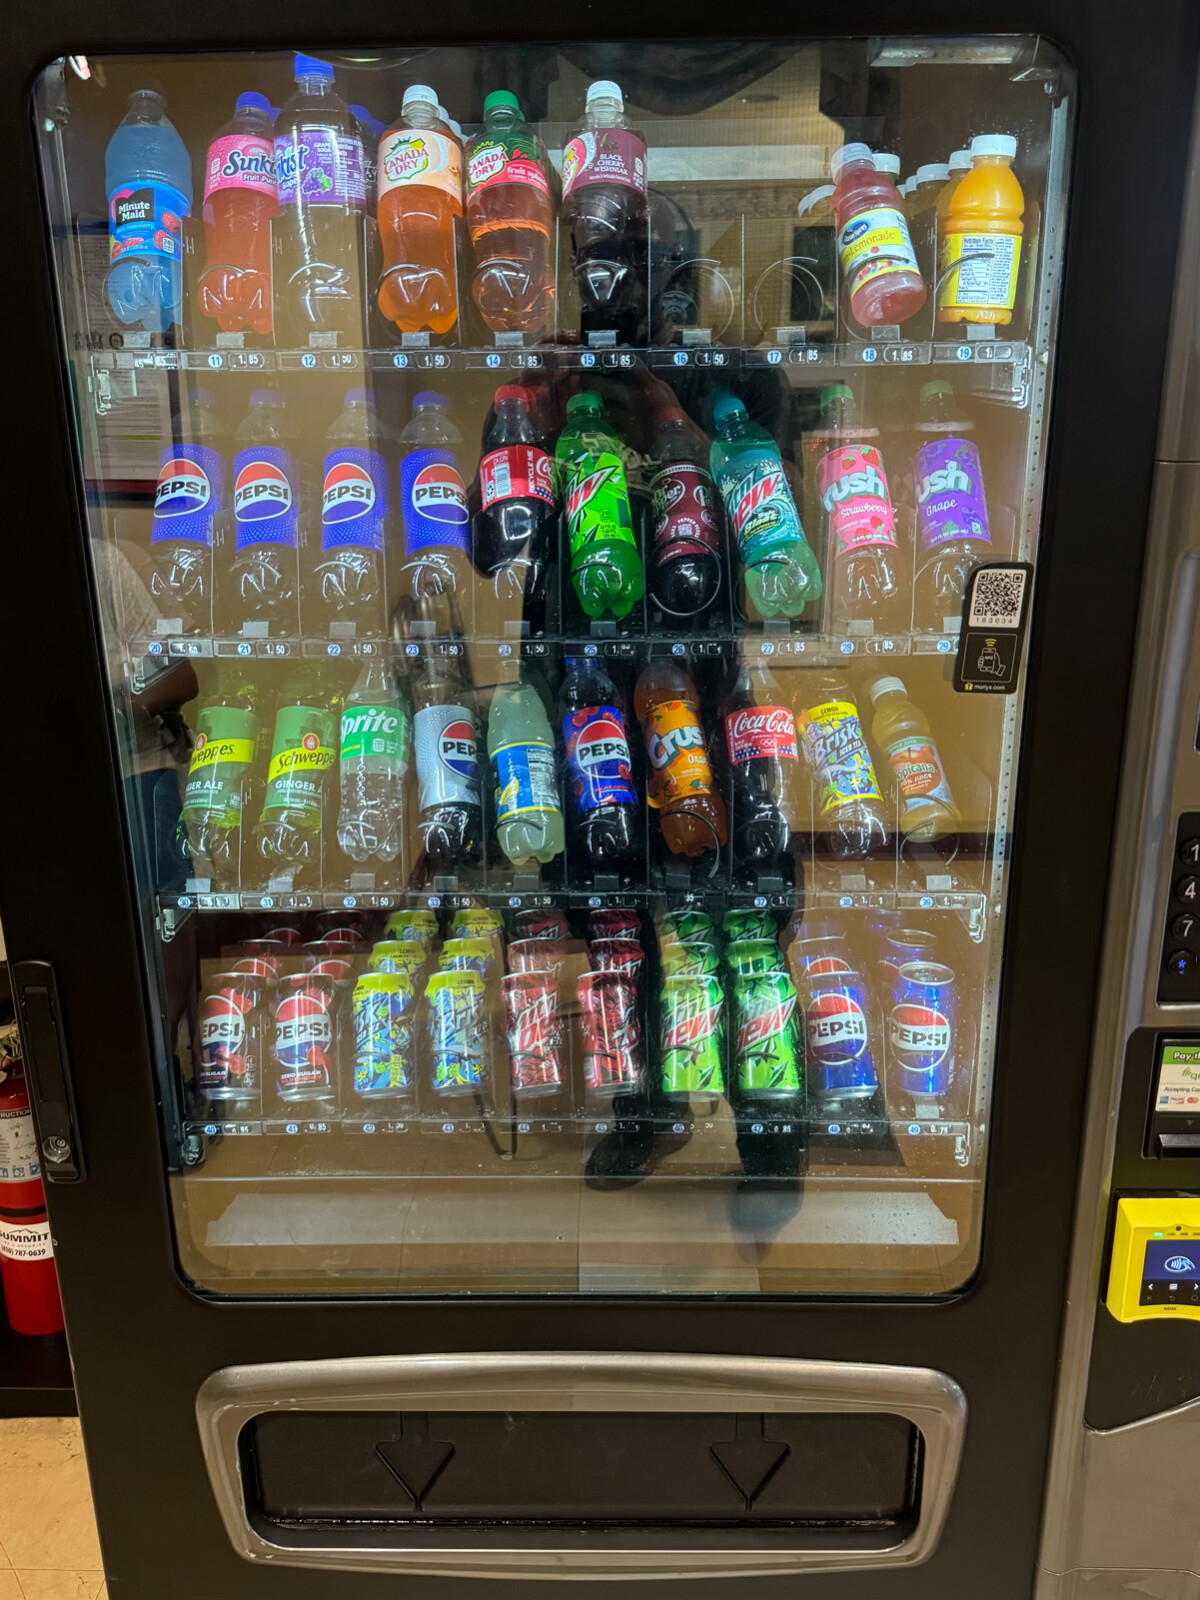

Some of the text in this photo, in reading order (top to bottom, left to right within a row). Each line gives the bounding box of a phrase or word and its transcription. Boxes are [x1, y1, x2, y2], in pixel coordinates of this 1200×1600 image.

[385, 148, 430, 175] CANADA
[600, 153, 623, 161] BLACK
[223, 151, 277, 177] Sunki
[395, 158, 420, 175] DRY
[468, 152, 508, 177] CANADA
[597, 160, 626, 168] CHERRY
[475, 164, 496, 180] DRY
[507, 166, 526, 175] fruit
[261, 176, 277, 185] Pun
[118, 201, 150, 214] Minute
[122, 210, 145, 221] Maid
[770, 349, 818, 363] 17 1.85
[865, 350, 913, 361] 18 1.85
[960, 347, 970, 358] 19
[211, 357, 221, 366] 11
[304, 356, 315, 366] 12
[396, 355, 444, 366] 13 1.50
[489, 354, 538, 367] 14 1.85
[583, 354, 631, 366] 15 1.85
[676, 353, 725, 365] 16 1.50
[918, 460, 970, 504] ush
[823, 465, 886, 513] rush
[236, 484, 288, 506] PEPSI
[416, 486, 466, 507] PEPS
[841, 503, 888, 519] Strawberry
[926, 498, 957, 516] Grape
[240, 643, 286, 654] 21 1.50
[330, 643, 372, 654] 22 1.50
[408, 644, 458, 656] 23 1.50
[501, 645, 510, 654] 24
[586, 645, 596, 654] 25
[674, 645, 683, 654] 26
[763, 644, 772, 653] 27
[842, 643, 852, 652] 28
[938, 642, 948, 651] 29
[820, 706, 839, 715] LEMON
[443, 741, 477, 756] PEP
[650, 726, 704, 769] Crus
[814, 721, 860, 768] Brisk
[192, 744, 235, 768] weppes
[277, 750, 335, 773] Schweppe
[896, 763, 936, 780] opicana
[204, 781, 224, 790] ALE
[275, 780, 316, 791] GINGER
[1191, 843, 1200, 861] 1
[1184, 881, 1196, 899] 4
[263, 898, 272, 907] 31
[345, 897, 355, 906] 32
[430, 898, 439, 907] 33
[756, 898, 766, 907] 37
[921, 897, 931, 907] 39
[1182, 919, 1193, 937] 7
[203, 1022, 241, 1038] EPSI
[808, 1020, 864, 1039] PEPSI
[891, 1024, 947, 1046] PEPSI
[1173, 1051, 1192, 1061] Pay
[1164, 1085, 1191, 1093] Accepting
[15, 1248, 46, 1256] 787-0639
